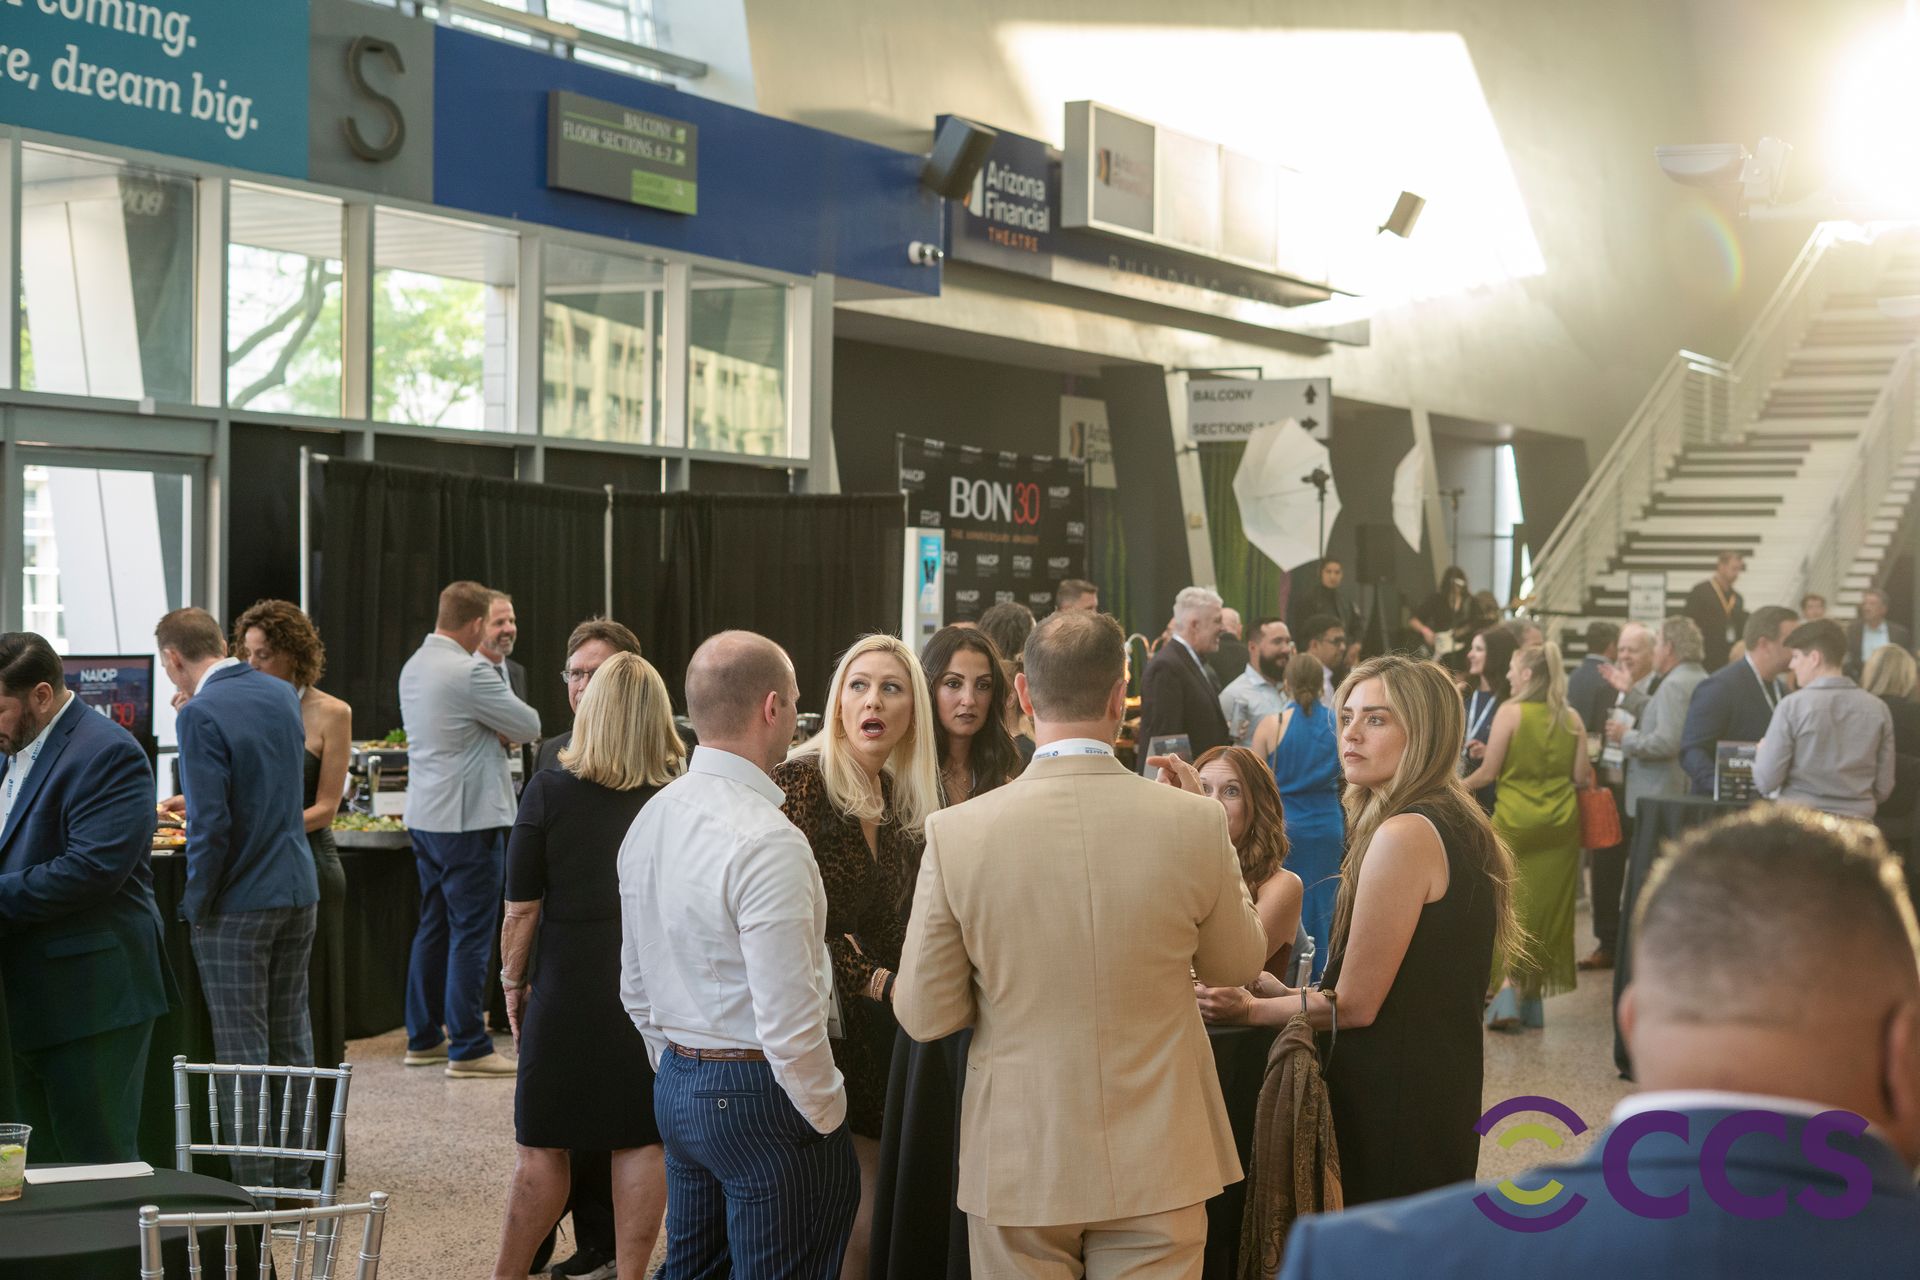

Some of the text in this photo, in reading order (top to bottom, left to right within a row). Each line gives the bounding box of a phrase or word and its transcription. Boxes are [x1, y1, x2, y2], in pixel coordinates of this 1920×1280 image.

[51, 44, 182, 115] dream
[191, 71, 259, 140] big.
[343, 35, 406, 163] S
[986, 160, 1046, 202] Arizona
[985, 191, 1050, 233] Financial
[988, 226, 1039, 253] THEATRE
[1192, 389, 1255, 402] BALCONY
[80, 668, 118, 682] NAIOP
